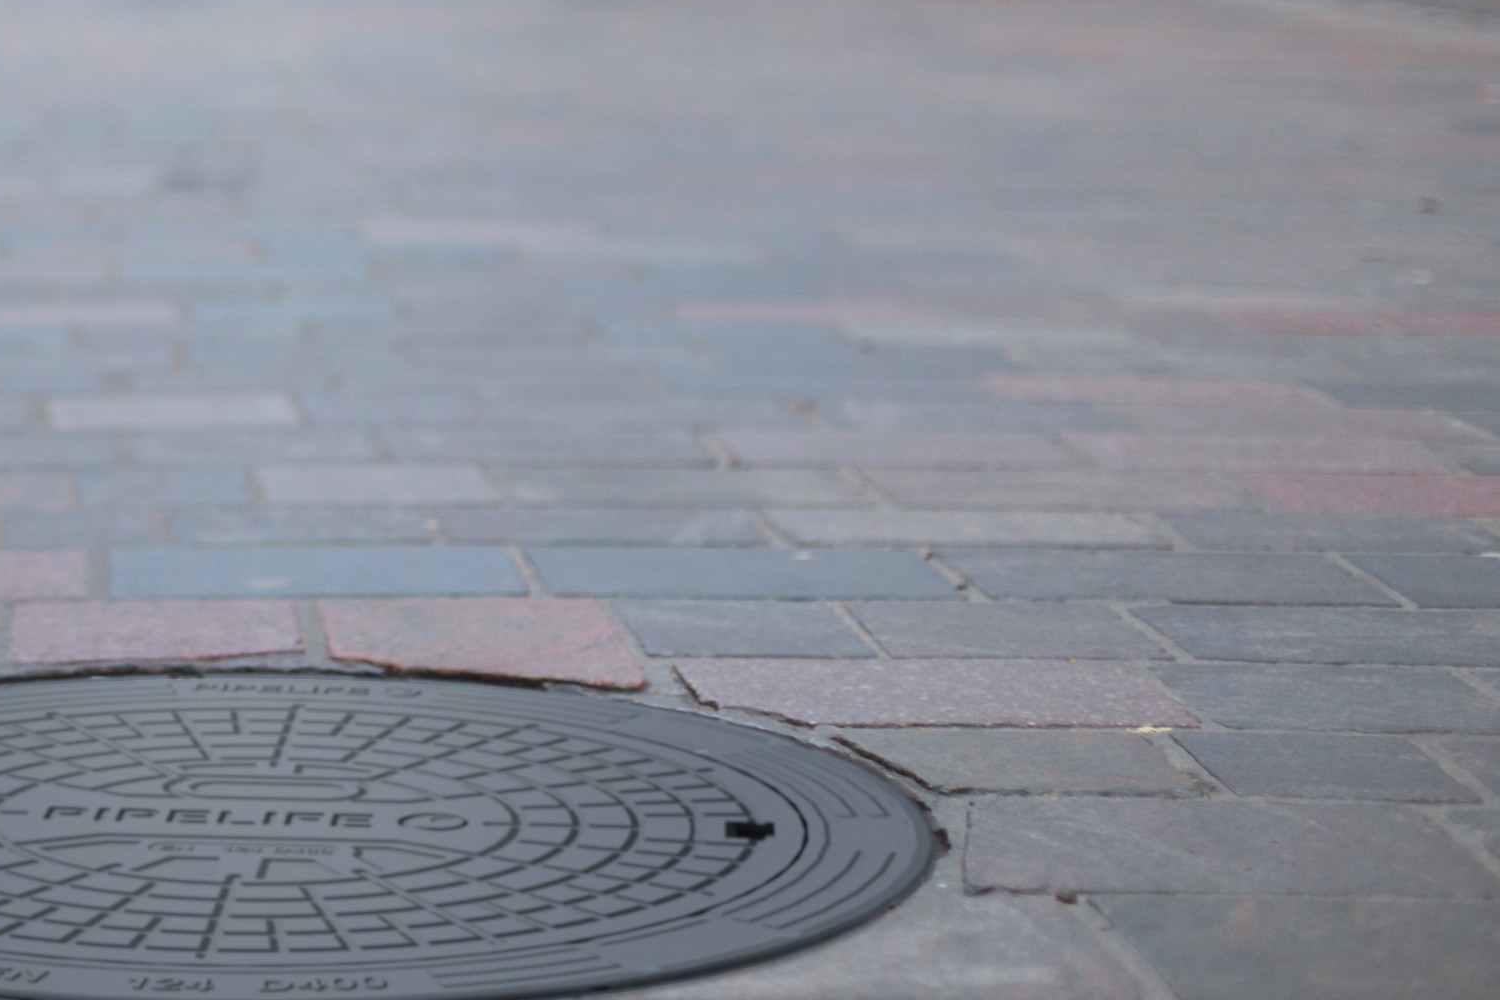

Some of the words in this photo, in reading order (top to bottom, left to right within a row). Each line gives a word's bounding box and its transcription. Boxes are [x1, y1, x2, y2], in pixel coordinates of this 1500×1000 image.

[193, 682, 370, 697] PIPELIFE
[42, 805, 374, 828] PIPELIFE
[129, 976, 215, 994] 124
[258, 975, 389, 994] D400
